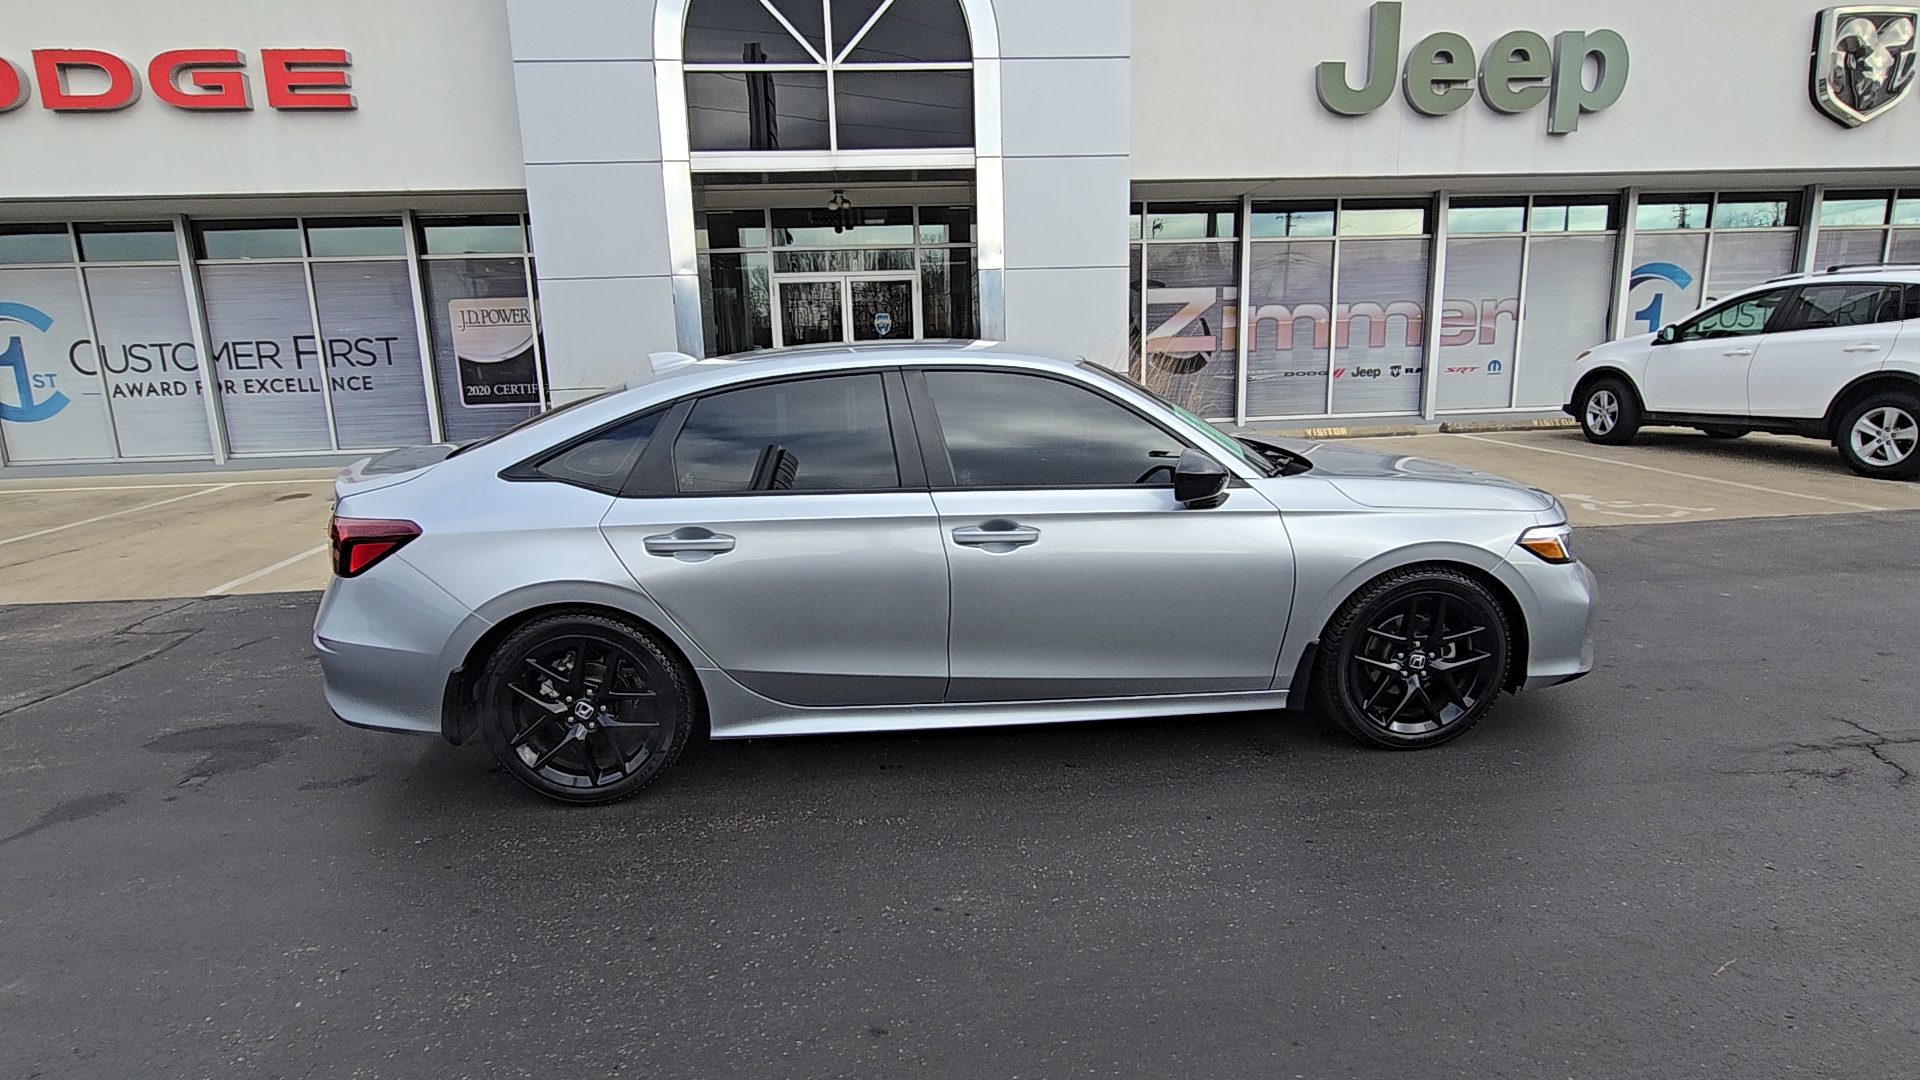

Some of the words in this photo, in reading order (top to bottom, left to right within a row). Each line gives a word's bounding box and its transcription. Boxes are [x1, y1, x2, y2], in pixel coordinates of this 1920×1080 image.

[0, 48, 358, 112] DGE
[1315, 1, 1630, 135] Jeep
[1145, 286, 1526, 352] Zimmer
[292, 335, 399, 370] FIRST
[112, 380, 187, 398] AWARD
[195, 379, 237, 396] FR
[244, 375, 374, 394] EXCELLNCE
[1351, 366, 1381, 379] Jeep
[1444, 366, 1480, 375] SRT
[466, 385, 491, 396] 2020
[493, 383, 539, 395] CERTIF
[1305, 427, 1347, 436] VISITOR
